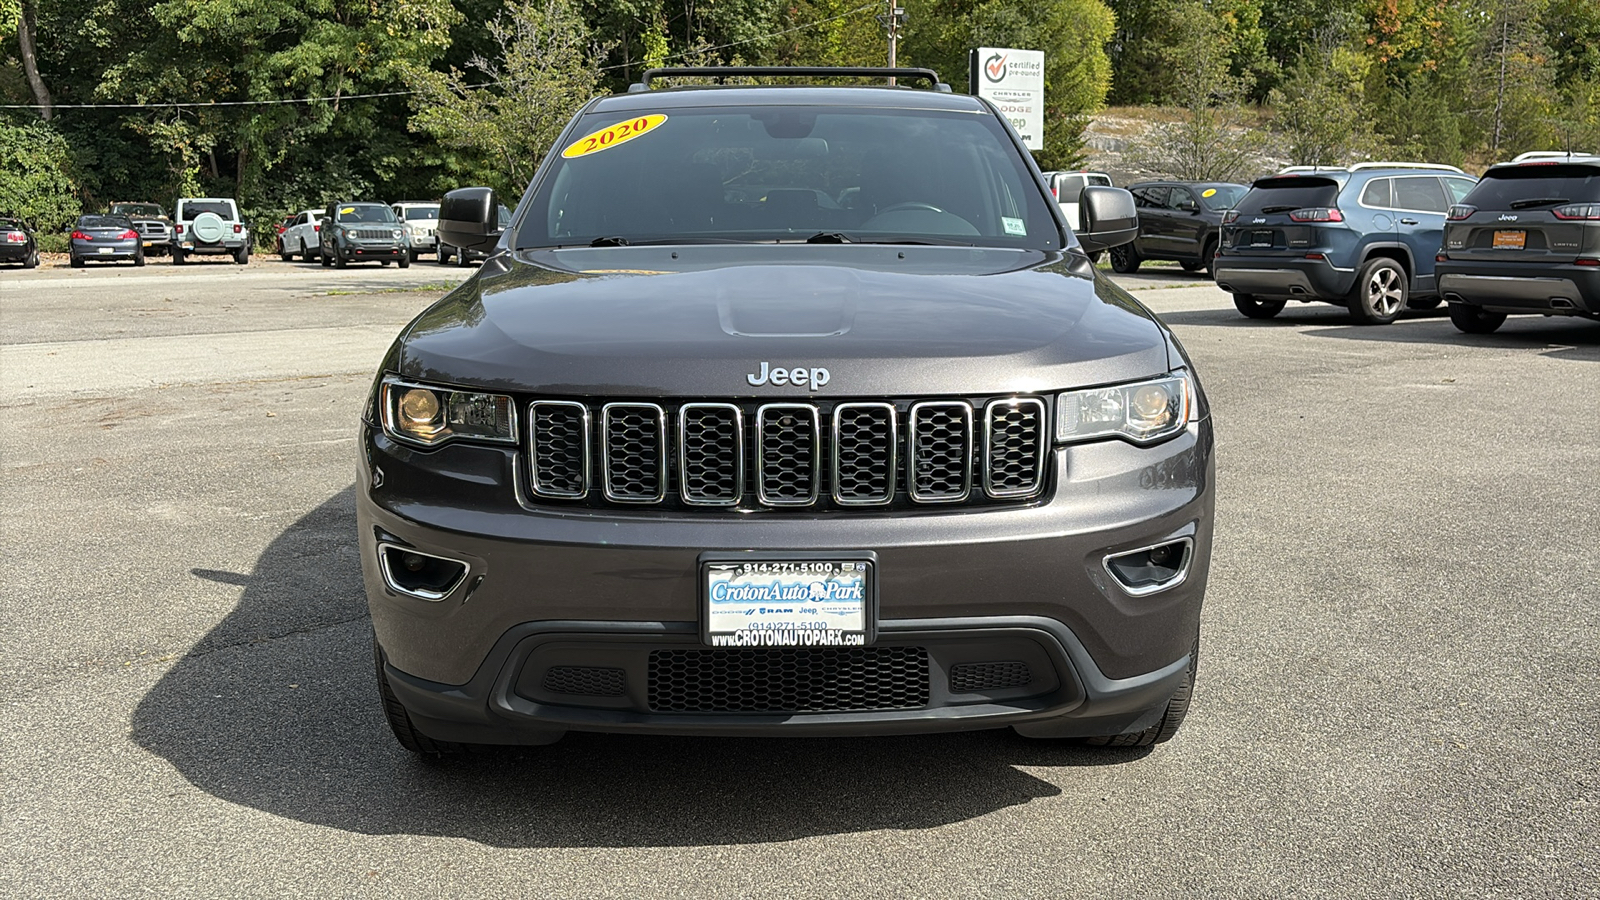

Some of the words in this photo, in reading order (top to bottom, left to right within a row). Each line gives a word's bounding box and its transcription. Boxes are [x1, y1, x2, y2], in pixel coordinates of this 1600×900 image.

[1009, 61, 1040, 70] certified
[1000, 105, 1032, 113] ODGE
[583, 118, 648, 153] 2020
[1498, 213, 1518, 222] Jeep
[747, 361, 831, 391] Jeep
[743, 563, 833, 573] 914-271-5100
[798, 607, 818, 615] Jeep
